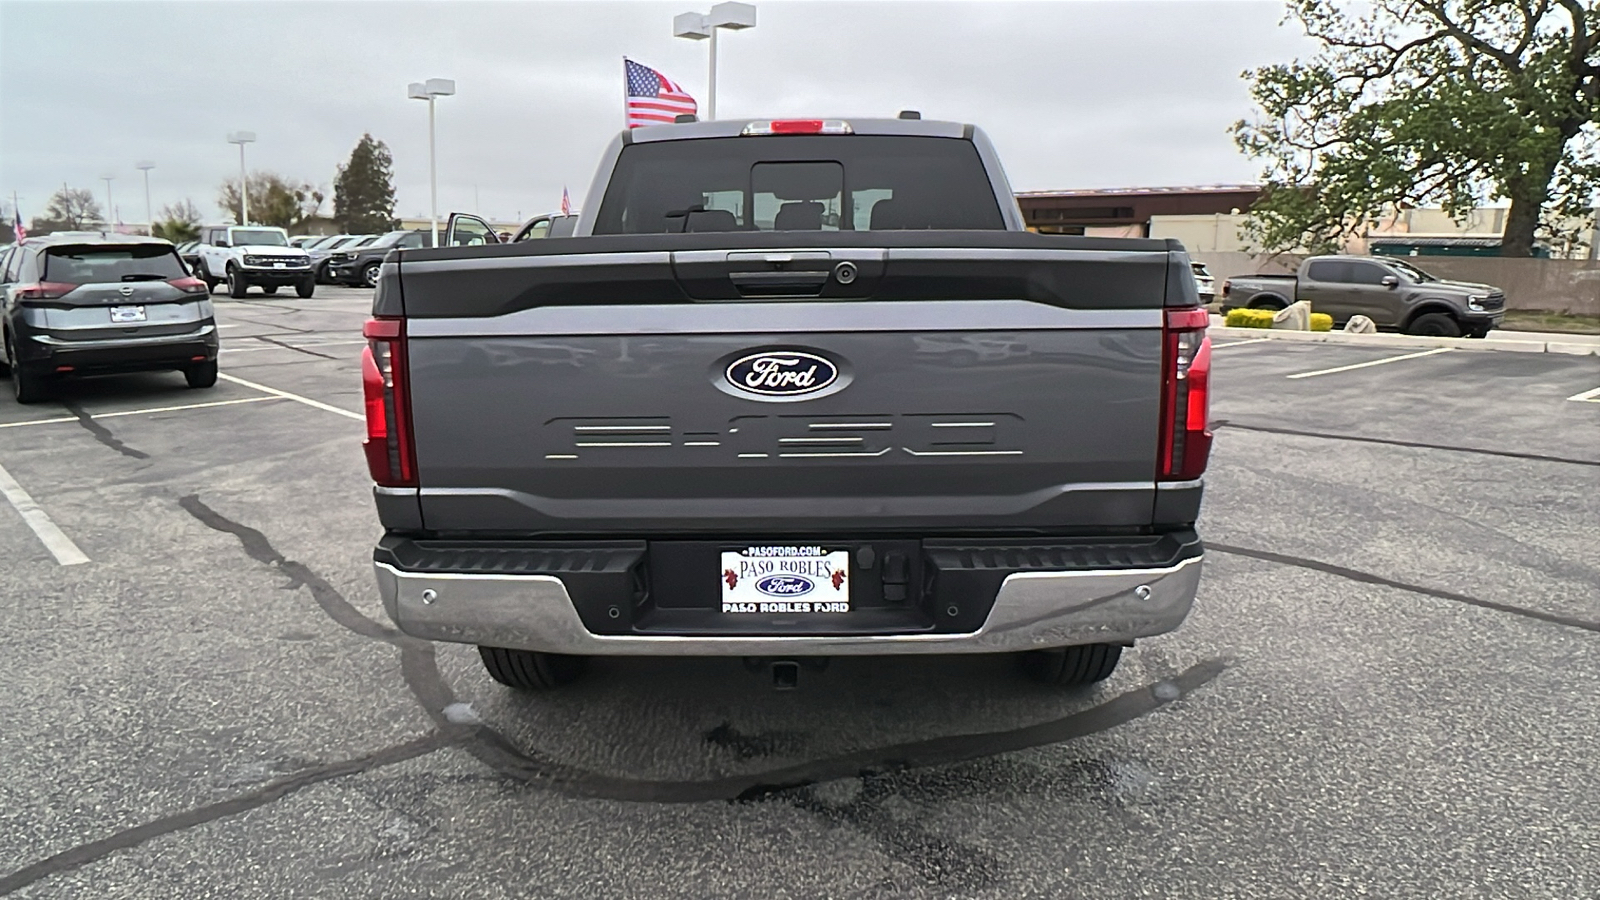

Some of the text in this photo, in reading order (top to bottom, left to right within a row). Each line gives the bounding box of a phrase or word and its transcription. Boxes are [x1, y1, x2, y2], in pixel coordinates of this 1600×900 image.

[745, 357, 818, 387] Ford
[543, 413, 1025, 459] F-150
[748, 546, 821, 557] PASOFORD.COM
[739, 560, 832, 579] PASO ROBLES
[767, 577, 804, 593] Ford
[722, 603, 757, 613] PASO
[760, 602, 811, 613] ROBLES
